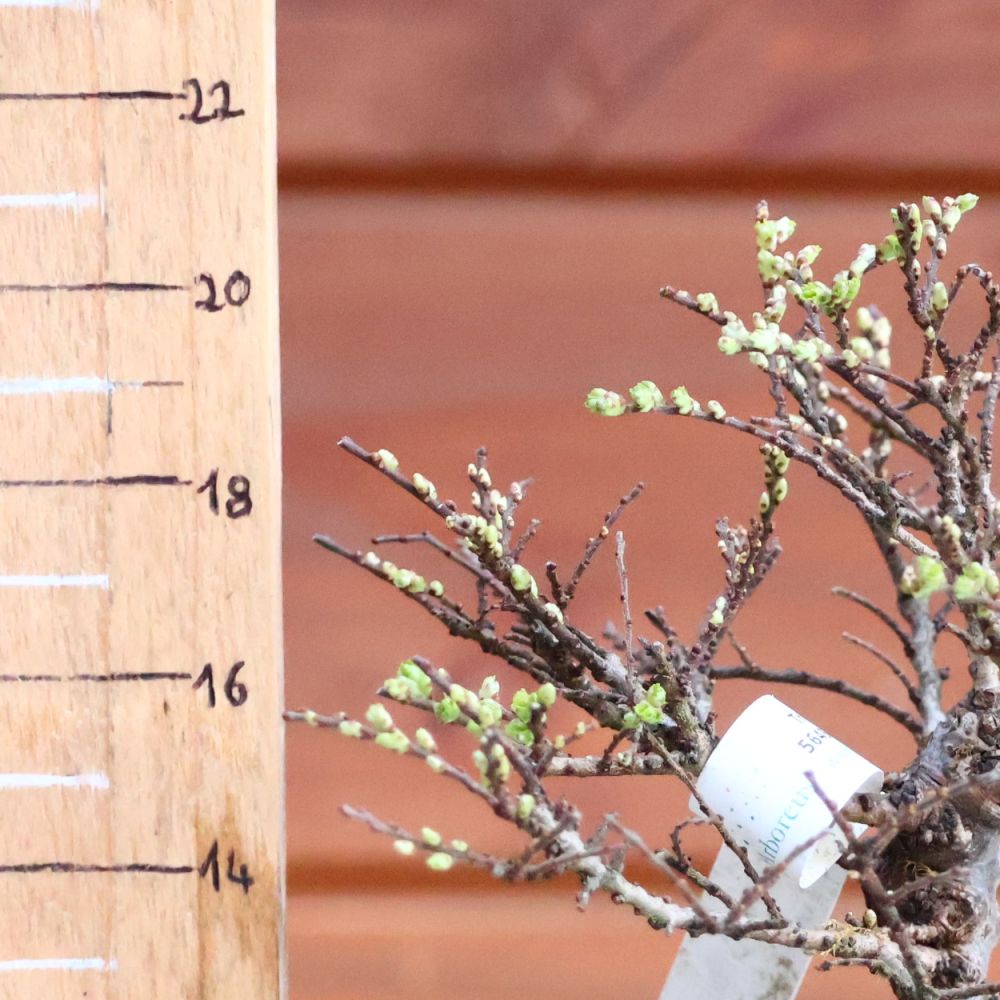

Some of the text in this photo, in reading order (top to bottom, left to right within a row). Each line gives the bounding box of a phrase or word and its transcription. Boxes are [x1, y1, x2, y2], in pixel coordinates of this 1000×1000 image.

[180, 78, 245, 124] 22
[195, 270, 251, 312] 20
[197, 469, 253, 518] 18
[193, 661, 248, 708] 16
[199, 840, 255, 894] 14
